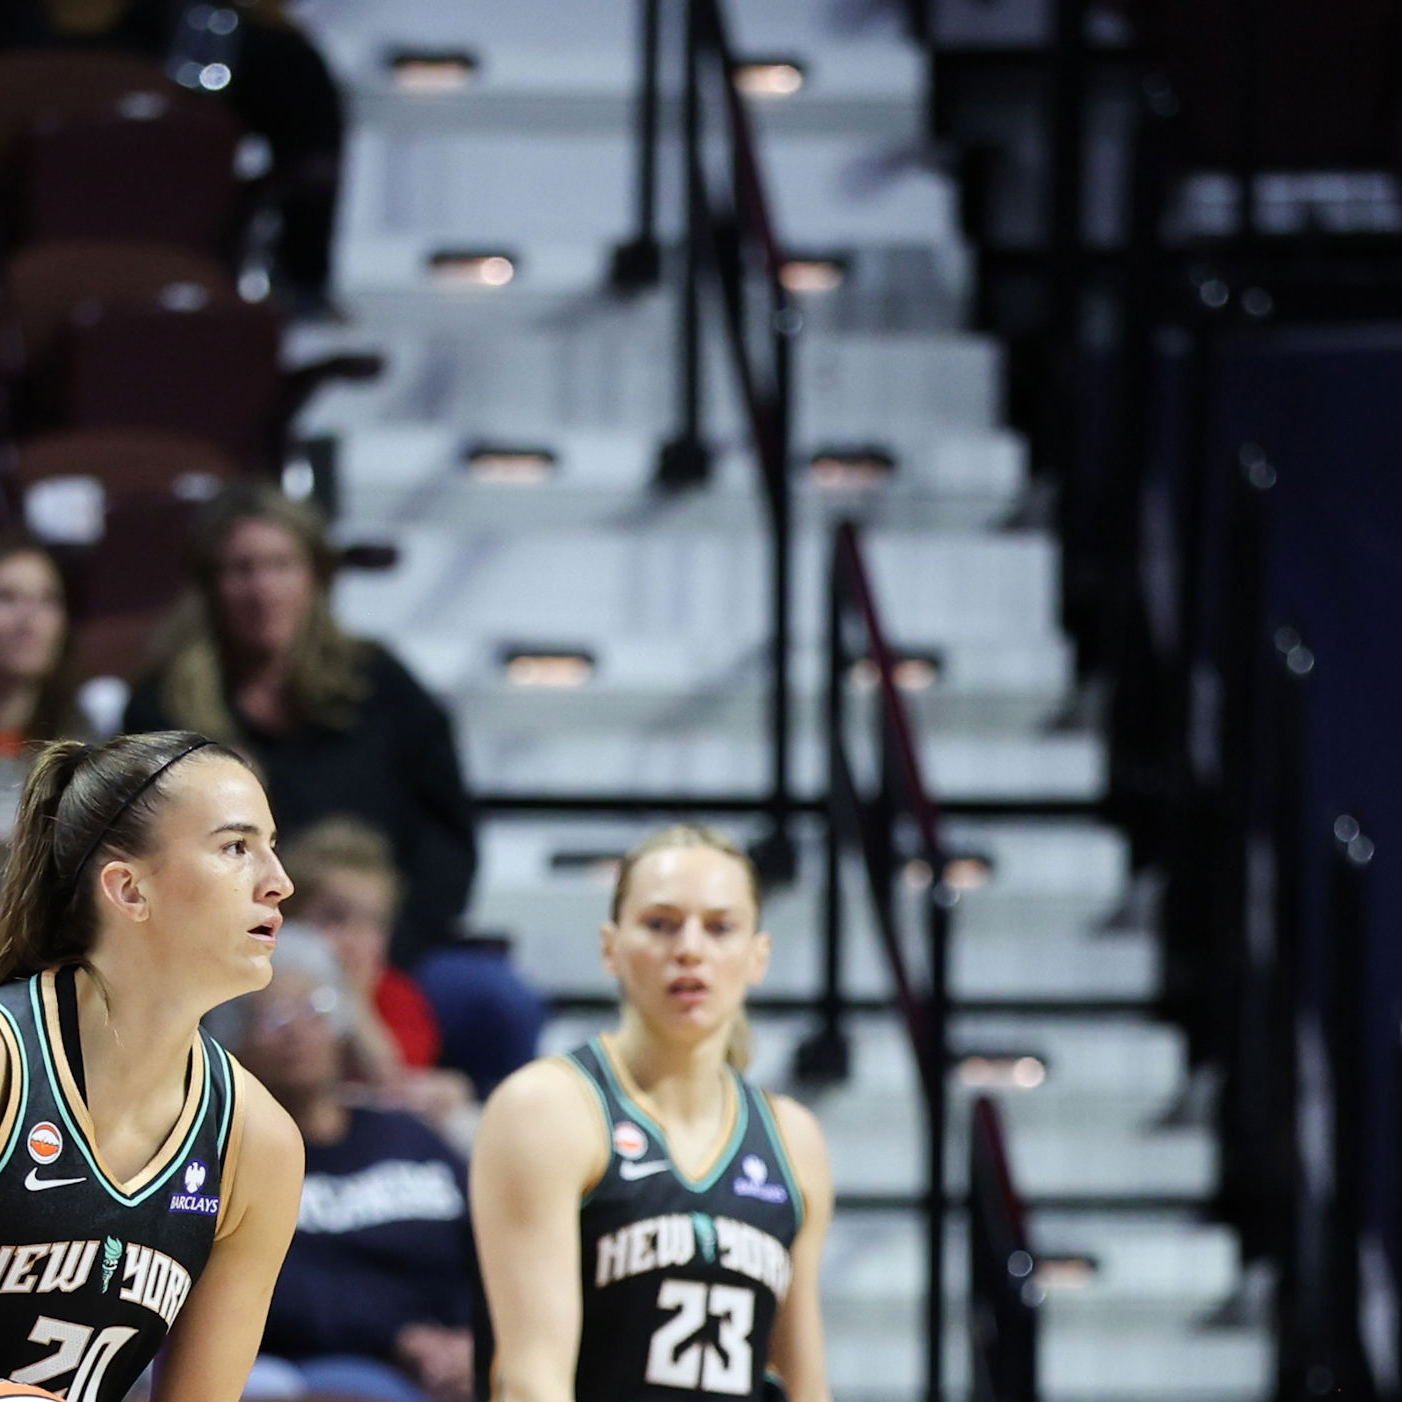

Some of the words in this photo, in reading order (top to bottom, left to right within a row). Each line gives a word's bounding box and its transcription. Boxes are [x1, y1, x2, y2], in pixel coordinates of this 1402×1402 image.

[170, 1195, 219, 1213] BARCLAYS
[596, 1212, 696, 1289] NEW
[645, 1277, 756, 1397] 23
